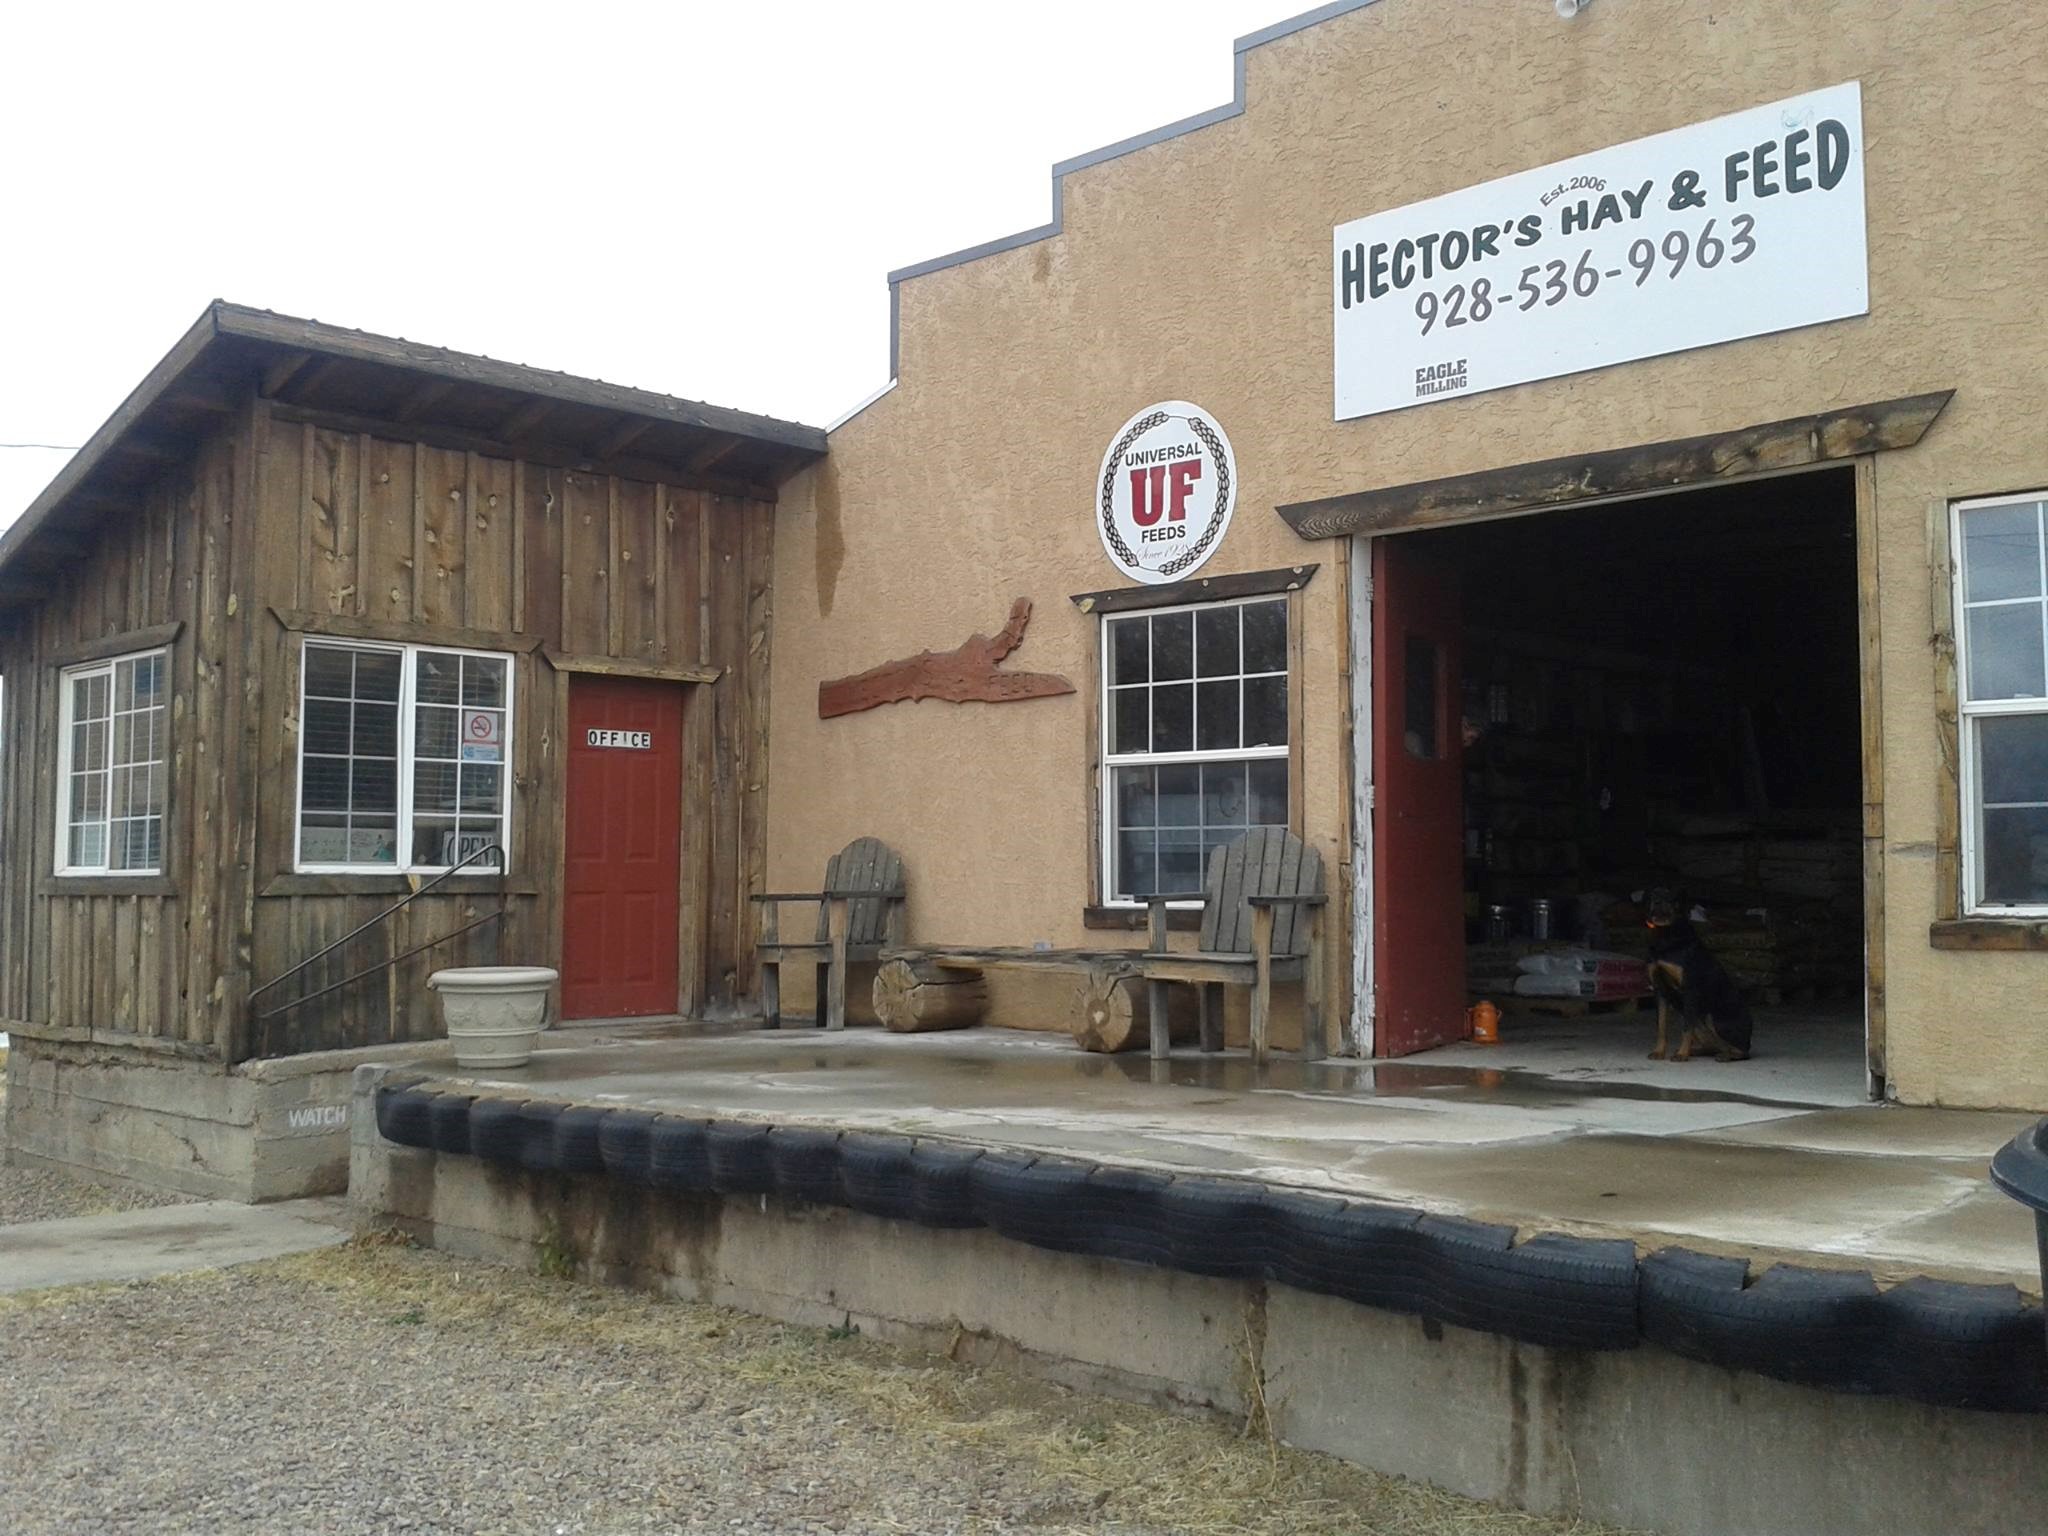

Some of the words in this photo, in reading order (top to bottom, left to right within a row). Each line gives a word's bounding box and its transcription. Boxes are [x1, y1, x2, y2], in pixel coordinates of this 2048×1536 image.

[1341, 215, 1542, 309] HECTOR'S
[1561, 179, 1654, 236] HAY
[1667, 170, 1706, 211] &
[1725, 119, 1850, 202] FEED
[1414, 214, 1757, 336] 928-536-9963
[1415, 358, 1467, 383] EAGLE
[1415, 375, 1467, 398] MILLING
[1125, 442, 1202, 466] UNIVERSAL
[1130, 458, 1202, 527] UF
[1141, 525, 1186, 543] FEEDS
[588, 730, 650, 747] OFFICE
[447, 836, 497, 866] OPEN
[289, 1105, 346, 1128] WATCH
